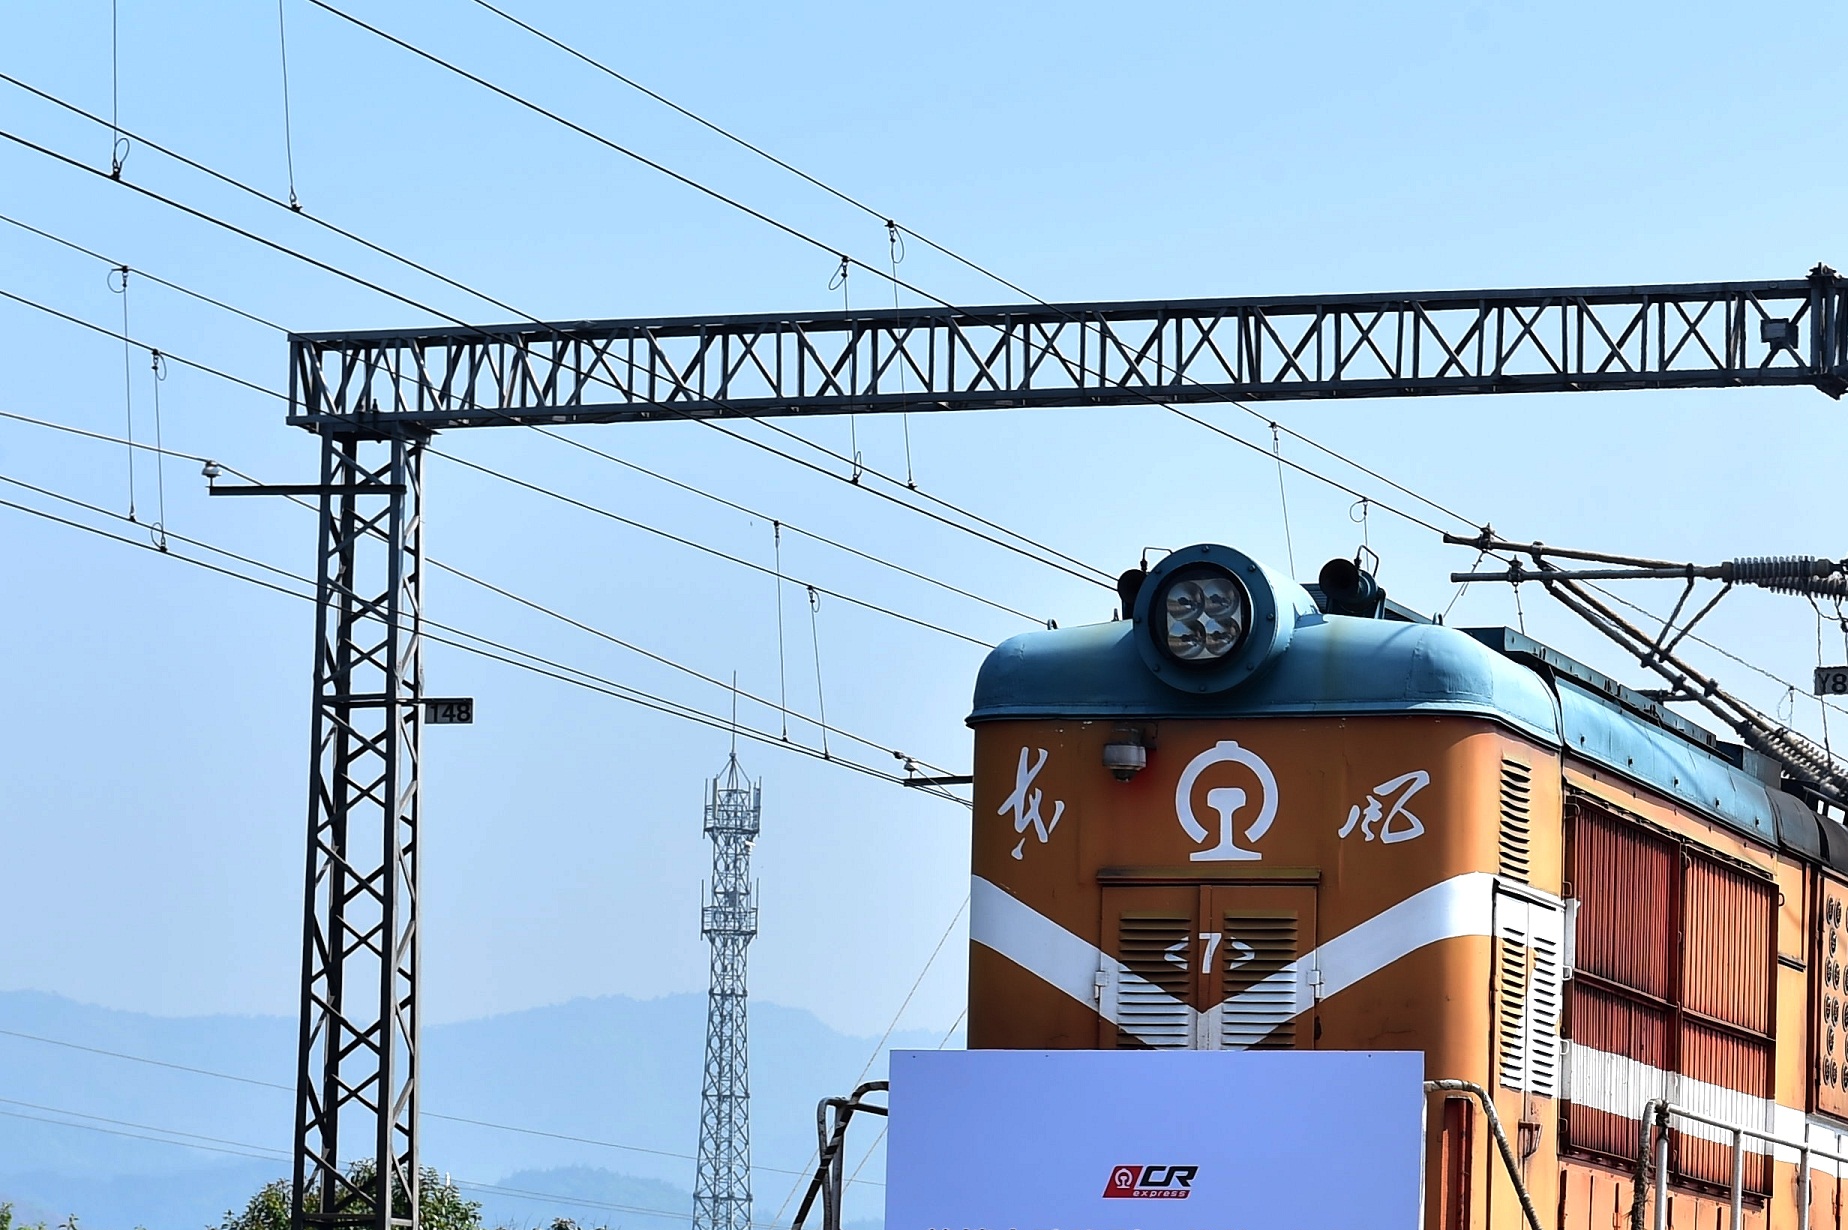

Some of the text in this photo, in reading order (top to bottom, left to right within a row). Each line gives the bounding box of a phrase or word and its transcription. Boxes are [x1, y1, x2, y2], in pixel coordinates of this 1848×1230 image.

[430, 702, 471, 723] 148
[1138, 1165, 1199, 1187] CR
[1132, 1189, 1187, 1198] express
